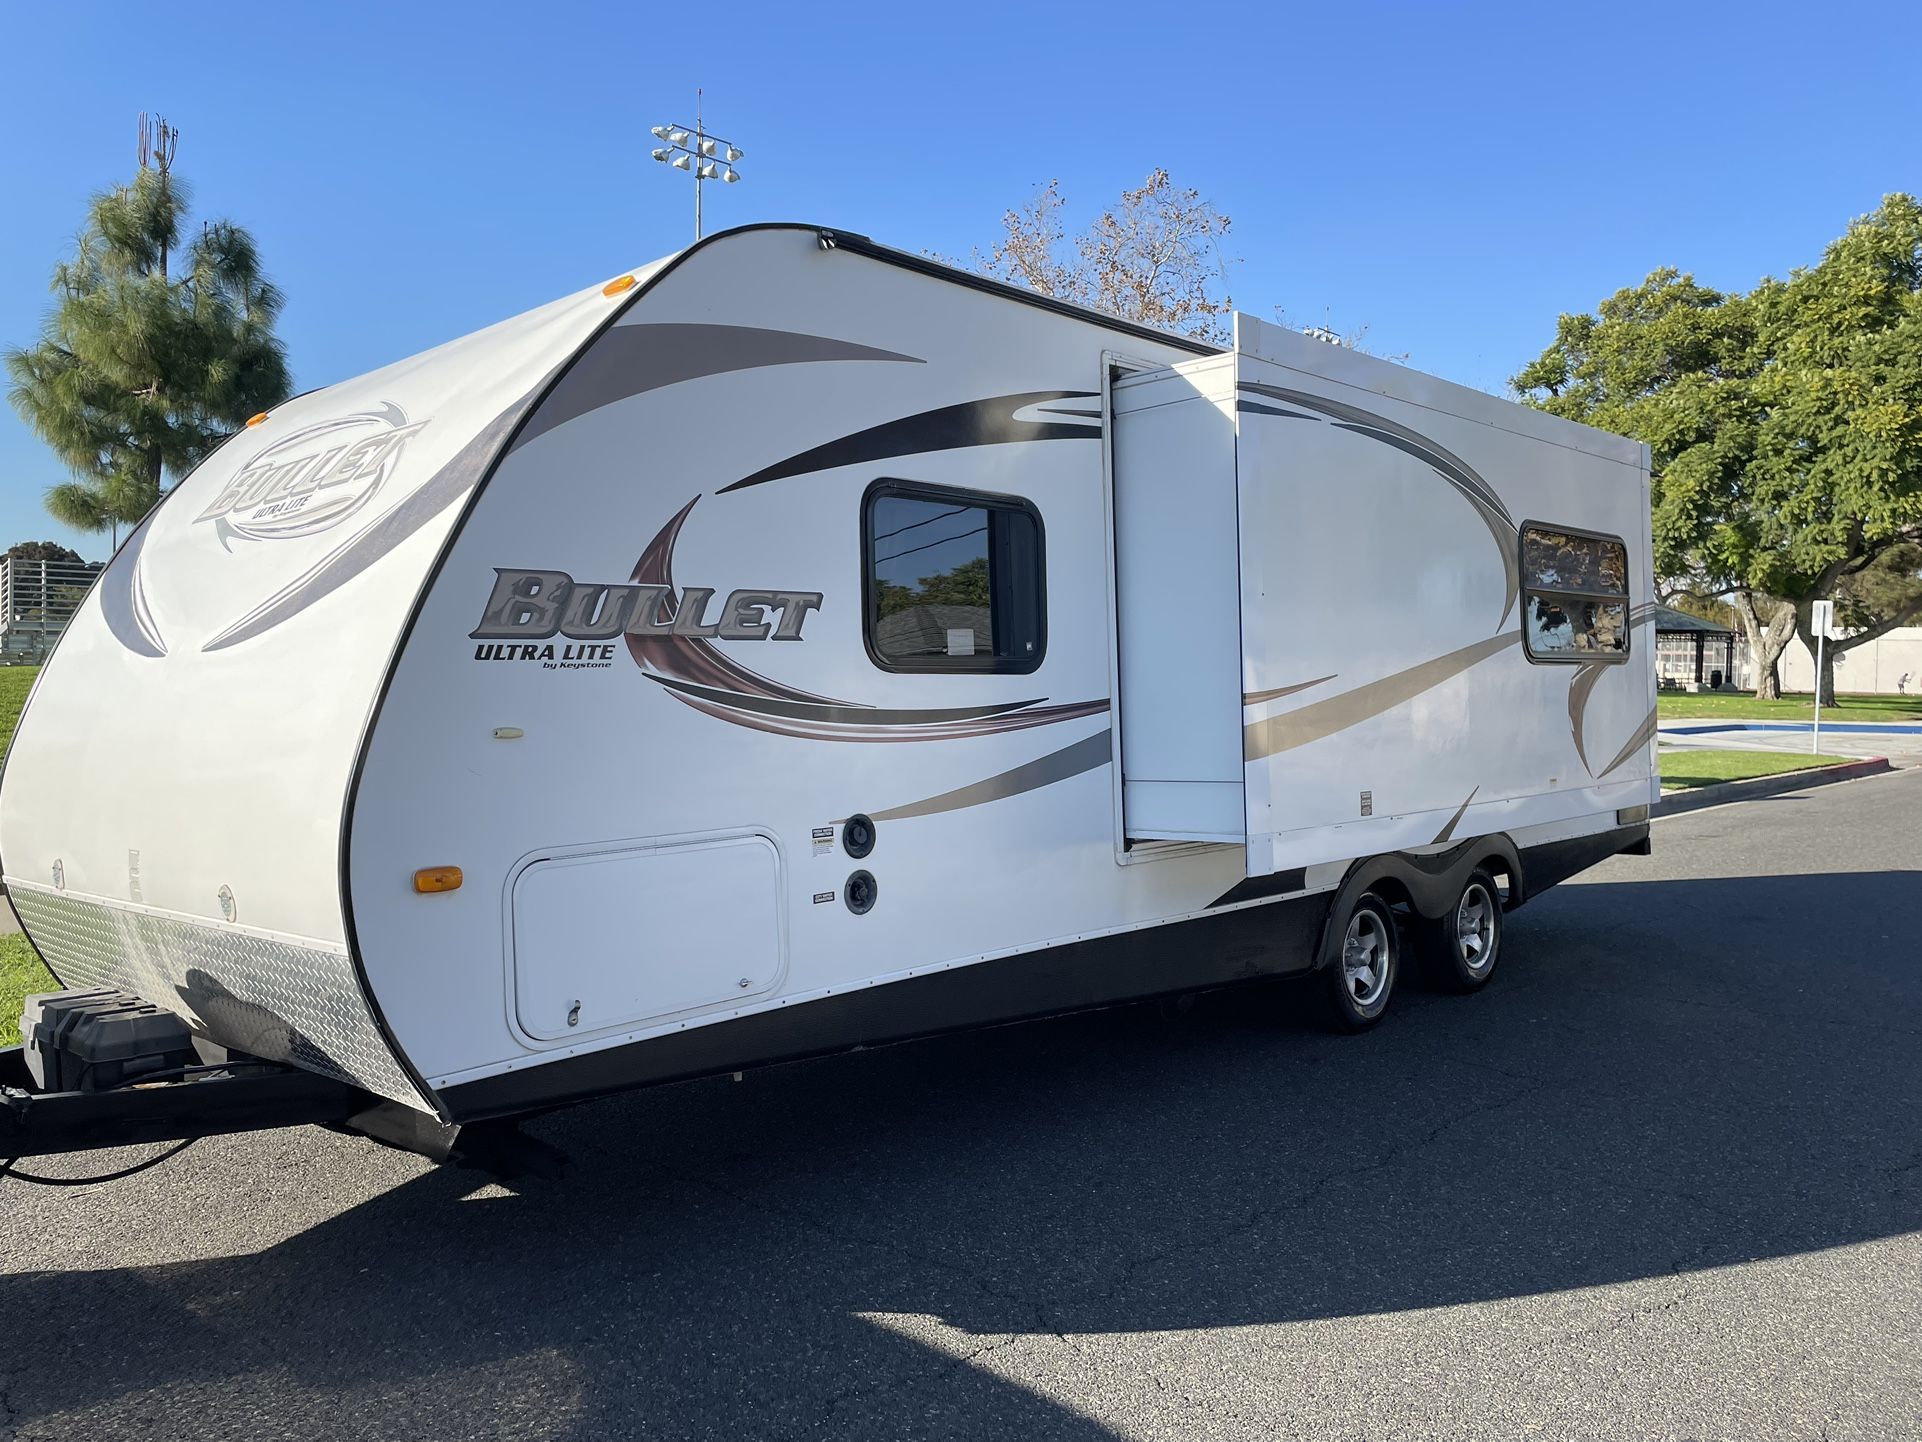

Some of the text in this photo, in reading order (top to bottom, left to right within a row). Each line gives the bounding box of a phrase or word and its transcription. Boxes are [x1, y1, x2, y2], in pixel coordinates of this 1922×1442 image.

[192, 419, 432, 523] BULLET
[252, 502, 285, 519] ULTRA
[284, 494, 313, 511] LITE
[468, 567, 824, 642] BULLET
[474, 644, 616, 661] ULTRA LITE
[542, 661, 612, 670] by Keystone
